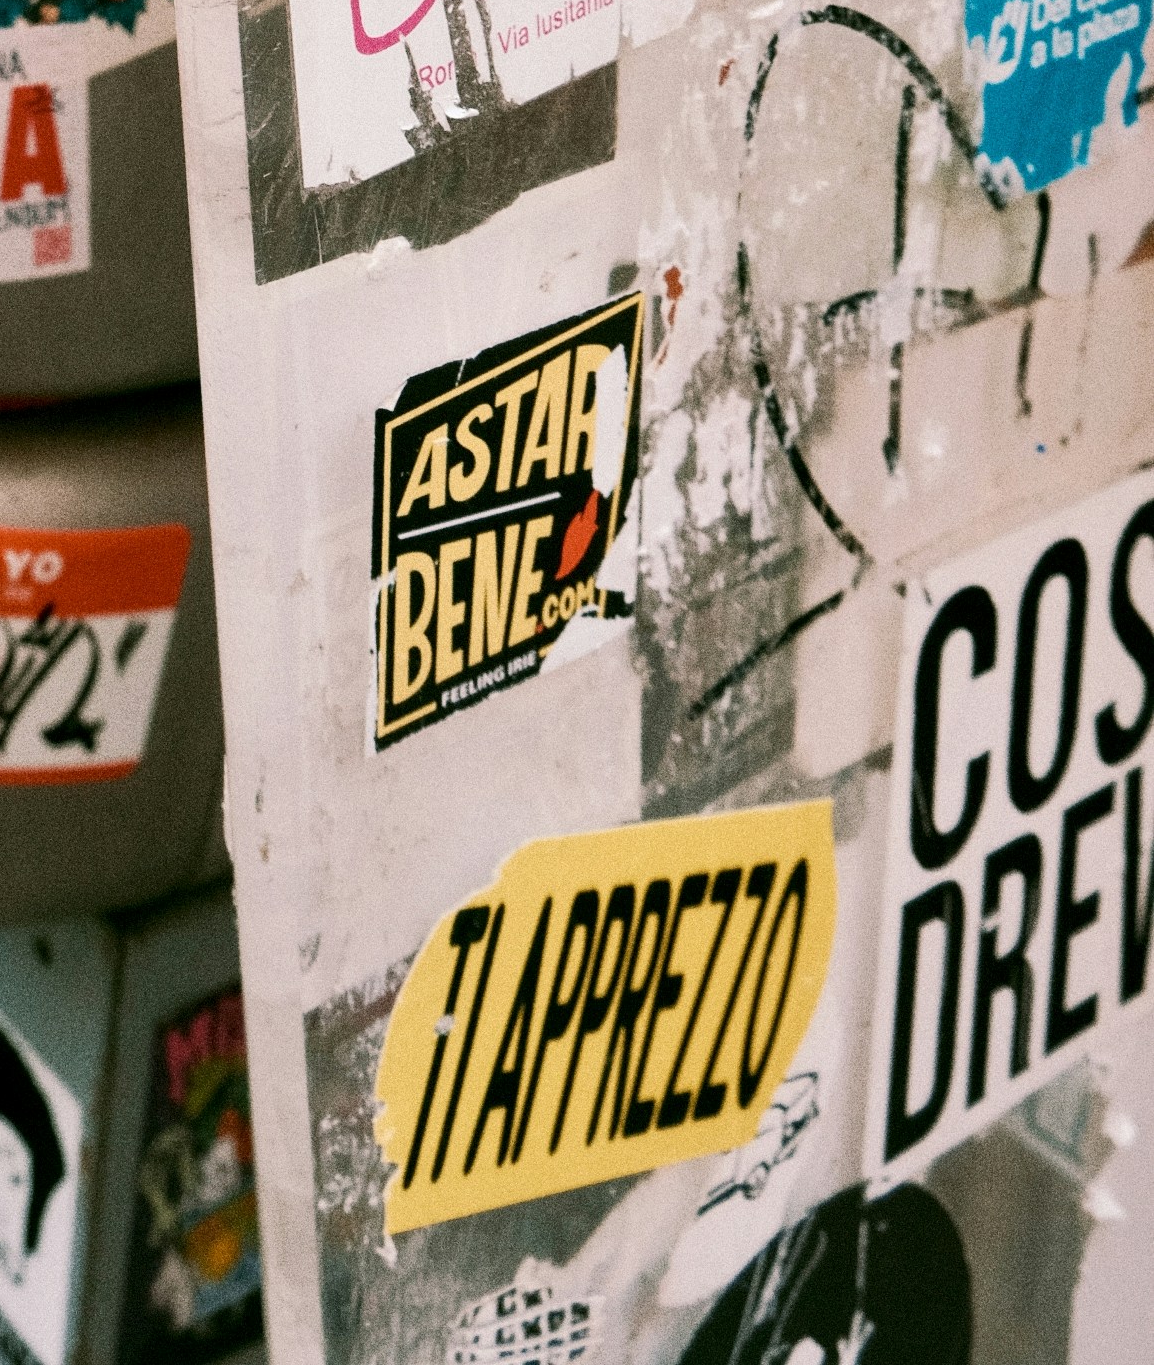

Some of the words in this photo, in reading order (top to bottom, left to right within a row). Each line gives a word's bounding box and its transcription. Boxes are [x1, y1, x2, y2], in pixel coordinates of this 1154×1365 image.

[496, 24, 530, 55] Via
[2, 548, 66, 585] YO
[441, 667, 507, 709] FEELING
[464, 857, 810, 1169] APPREZZO
